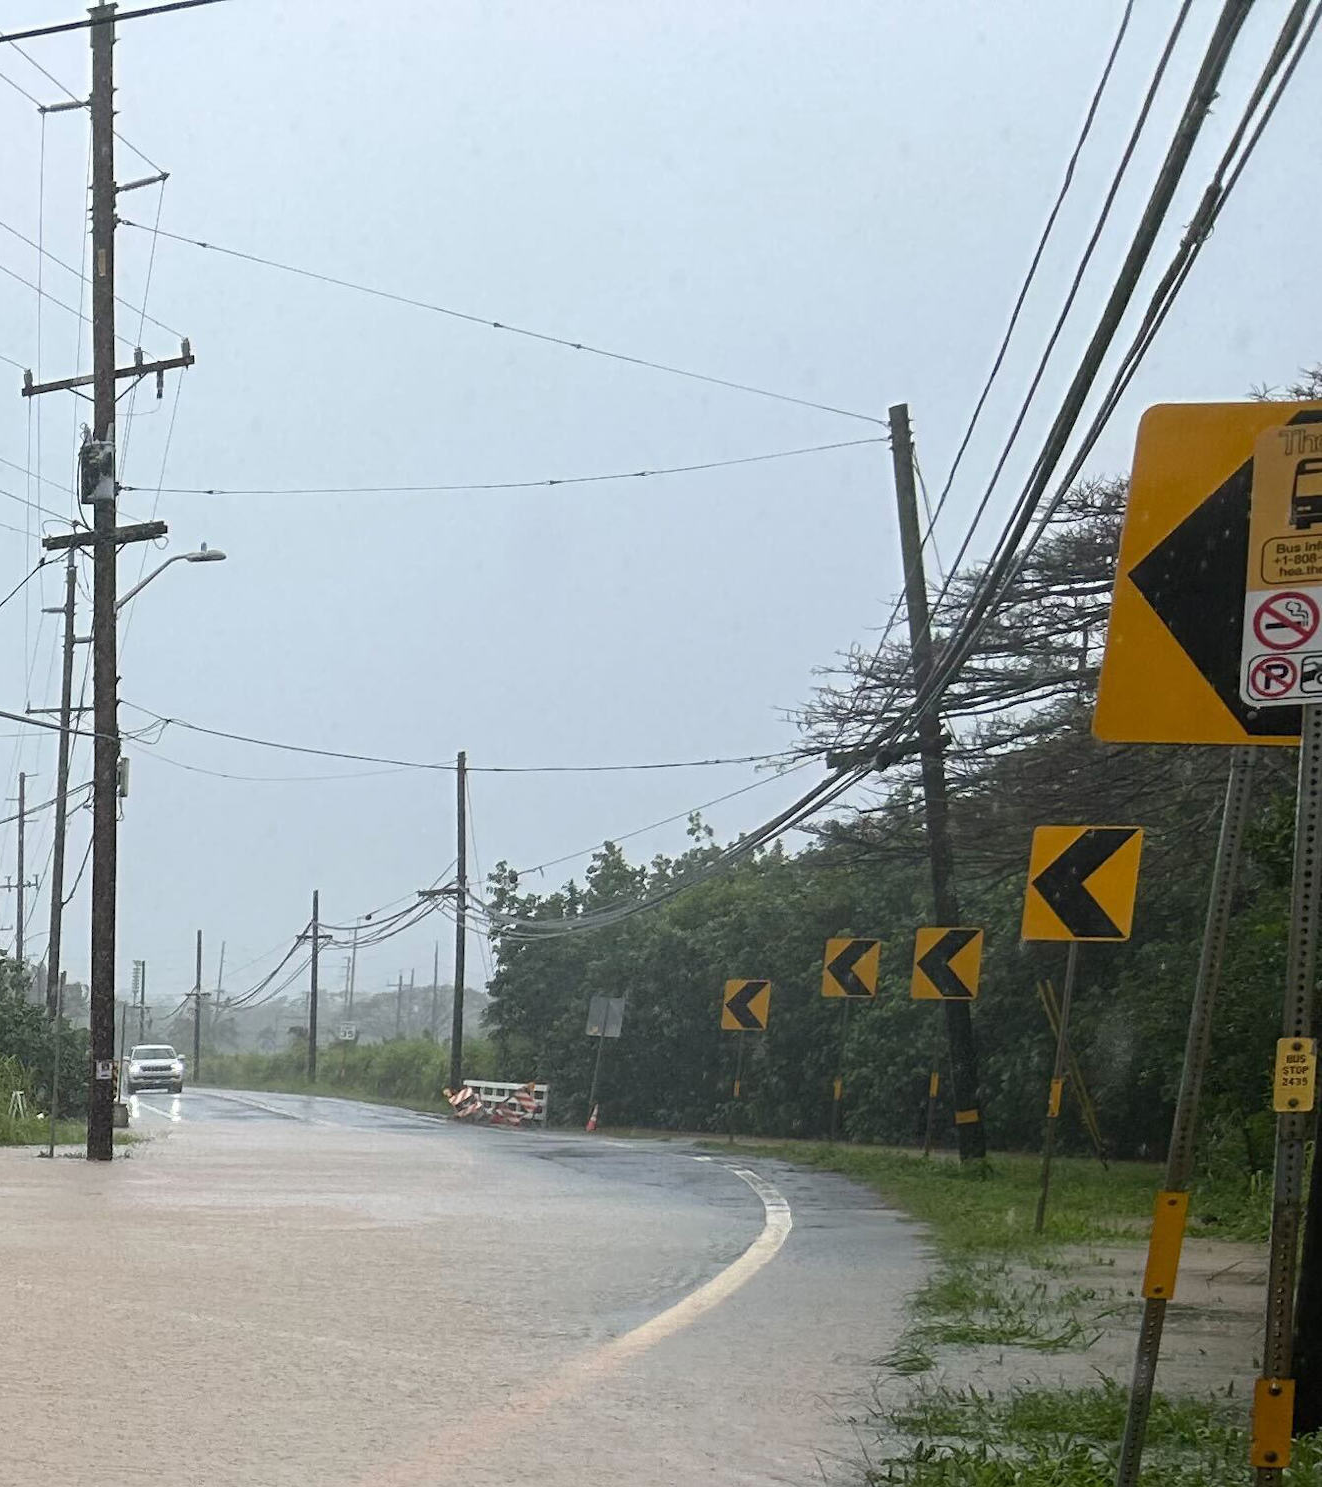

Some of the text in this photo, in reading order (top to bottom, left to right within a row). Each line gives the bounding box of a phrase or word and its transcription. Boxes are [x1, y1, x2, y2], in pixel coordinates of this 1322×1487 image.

[1277, 543, 1301, 554] Bus
[342, 1030, 353, 1039] 35
[1286, 1054, 1306, 1063] BUS
[1282, 1065, 1309, 1075] STOP
